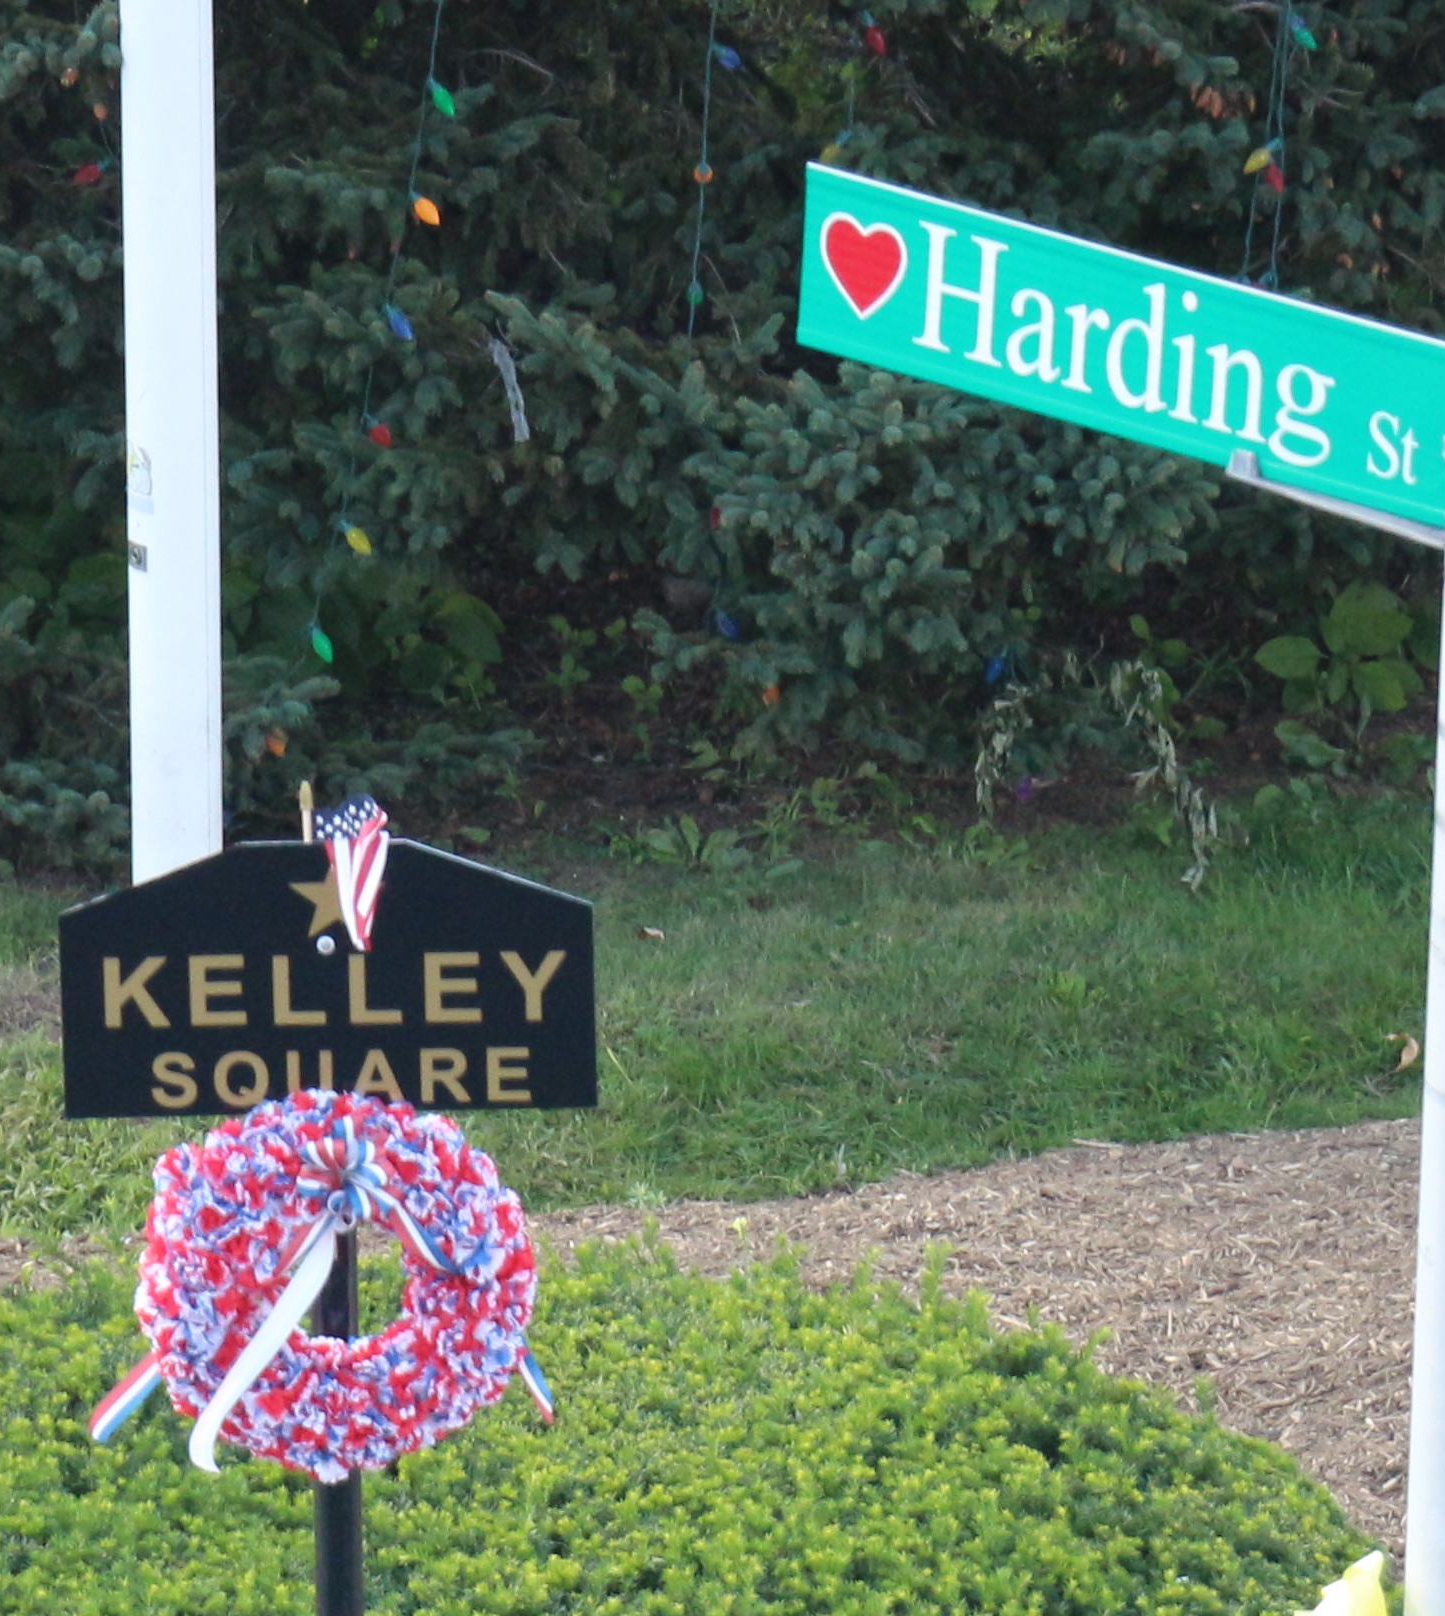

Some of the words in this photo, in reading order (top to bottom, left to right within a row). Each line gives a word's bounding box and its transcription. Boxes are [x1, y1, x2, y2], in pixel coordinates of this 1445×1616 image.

[912, 219, 1336, 468] Harding
[1366, 410, 1420, 486] St
[101, 949, 568, 1030] KELLEY
[151, 1046, 533, 1109] SQUARE
